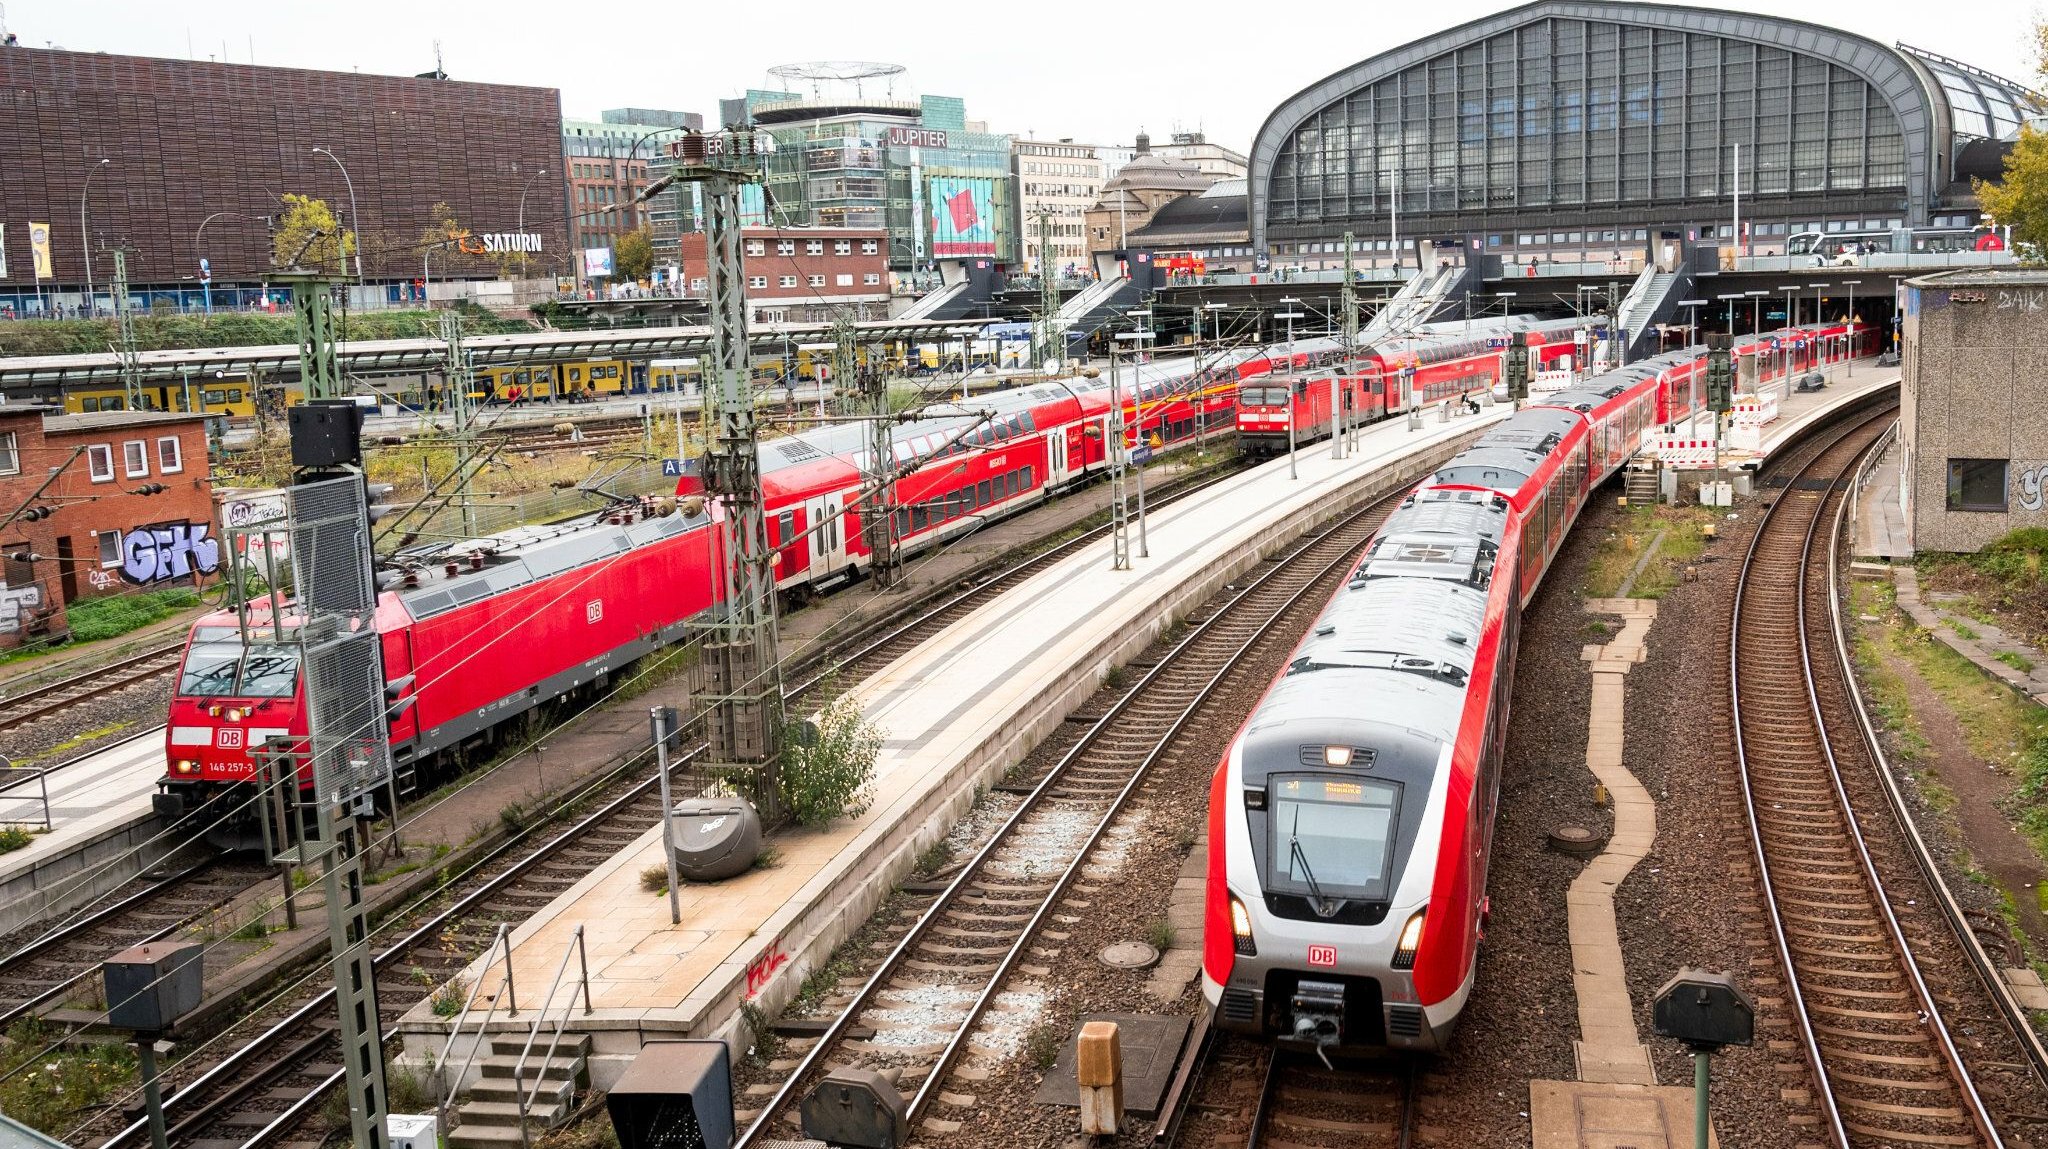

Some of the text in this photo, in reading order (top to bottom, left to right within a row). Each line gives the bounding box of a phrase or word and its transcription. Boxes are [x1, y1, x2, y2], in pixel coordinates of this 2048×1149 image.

[891, 128, 946, 147] JUPITER
[483, 233, 542, 252] SATURN
[665, 460, 676, 474] A
[589, 602, 601, 620] DB
[219, 730, 241, 747] DB
[209, 762, 254, 772] 146 257-3
[1310, 947, 1334, 964] DB
